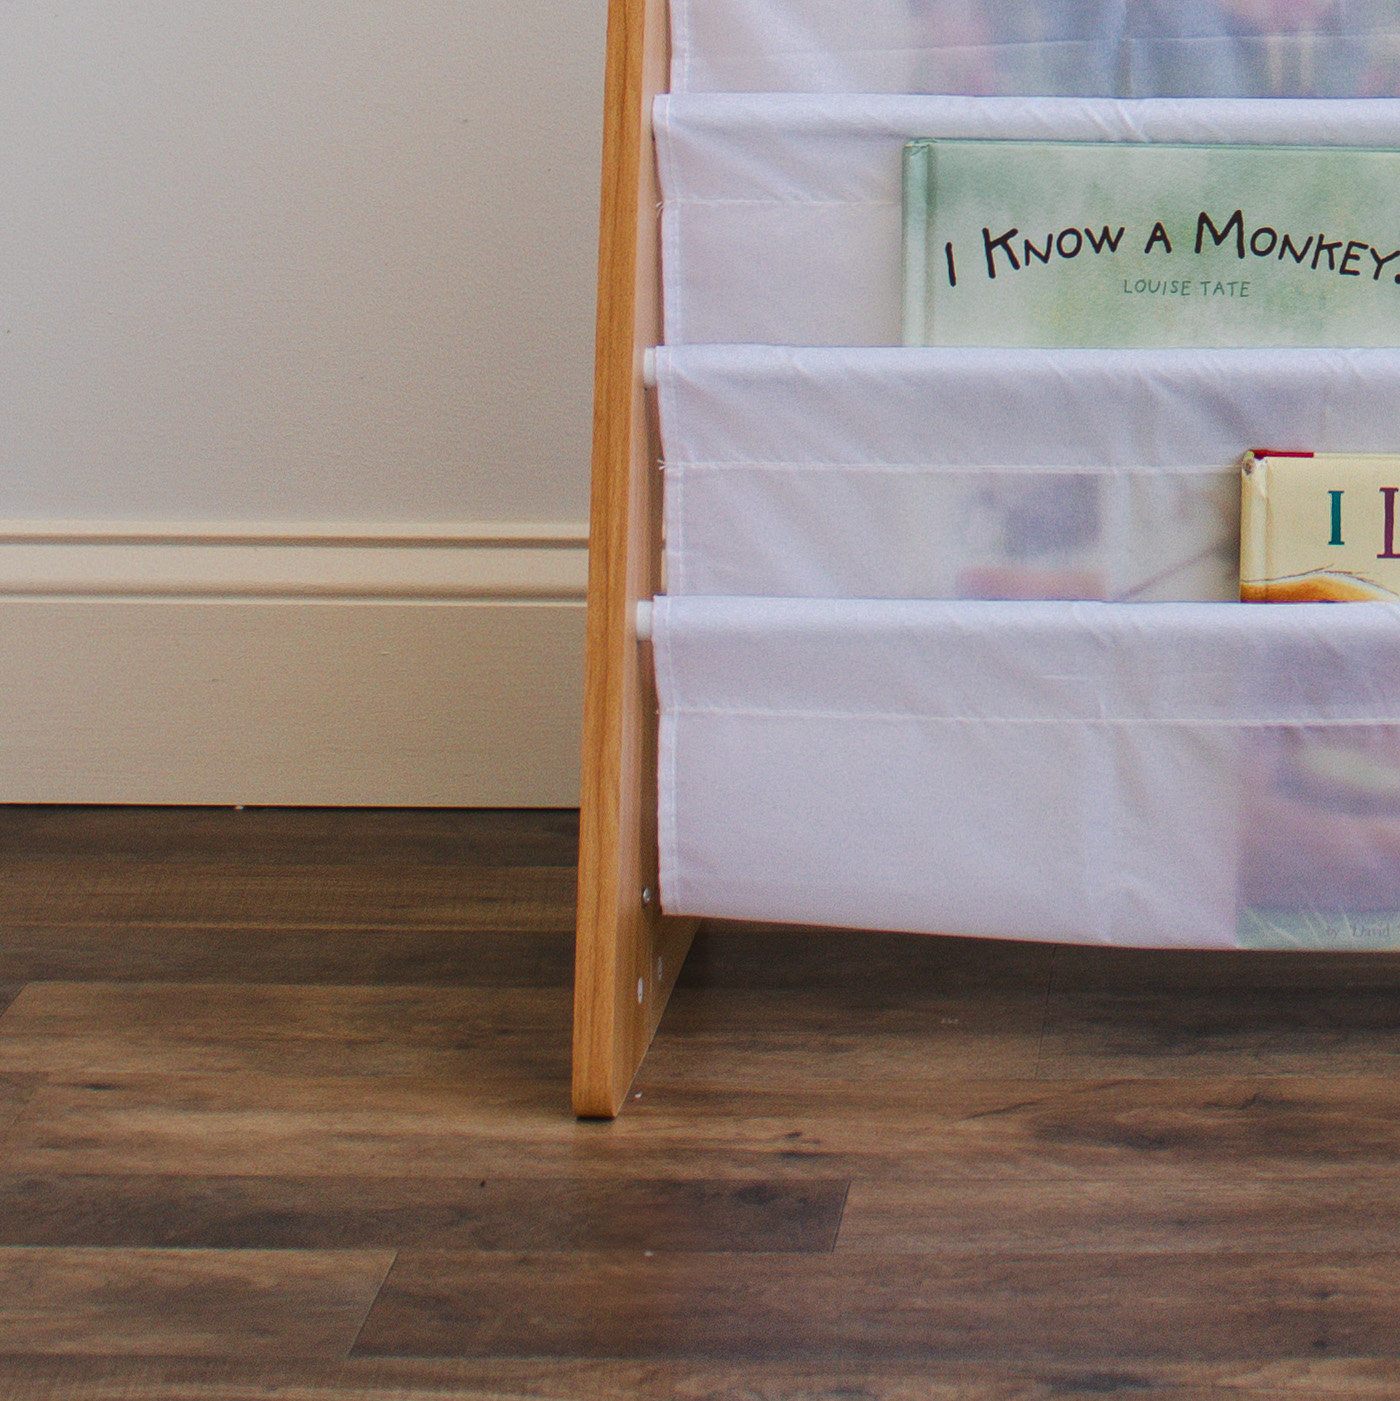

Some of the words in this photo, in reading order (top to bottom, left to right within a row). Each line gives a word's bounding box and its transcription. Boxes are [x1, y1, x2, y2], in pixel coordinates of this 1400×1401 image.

[944, 241, 958, 287] I
[981, 226, 1126, 279] KNOW
[1143, 221, 1173, 254] A
[1122, 278, 1192, 297] LOUISE
[1199, 280, 1252, 298] TATE
[1327, 490, 1346, 547] I
[1351, 922, 1390, 937] David
